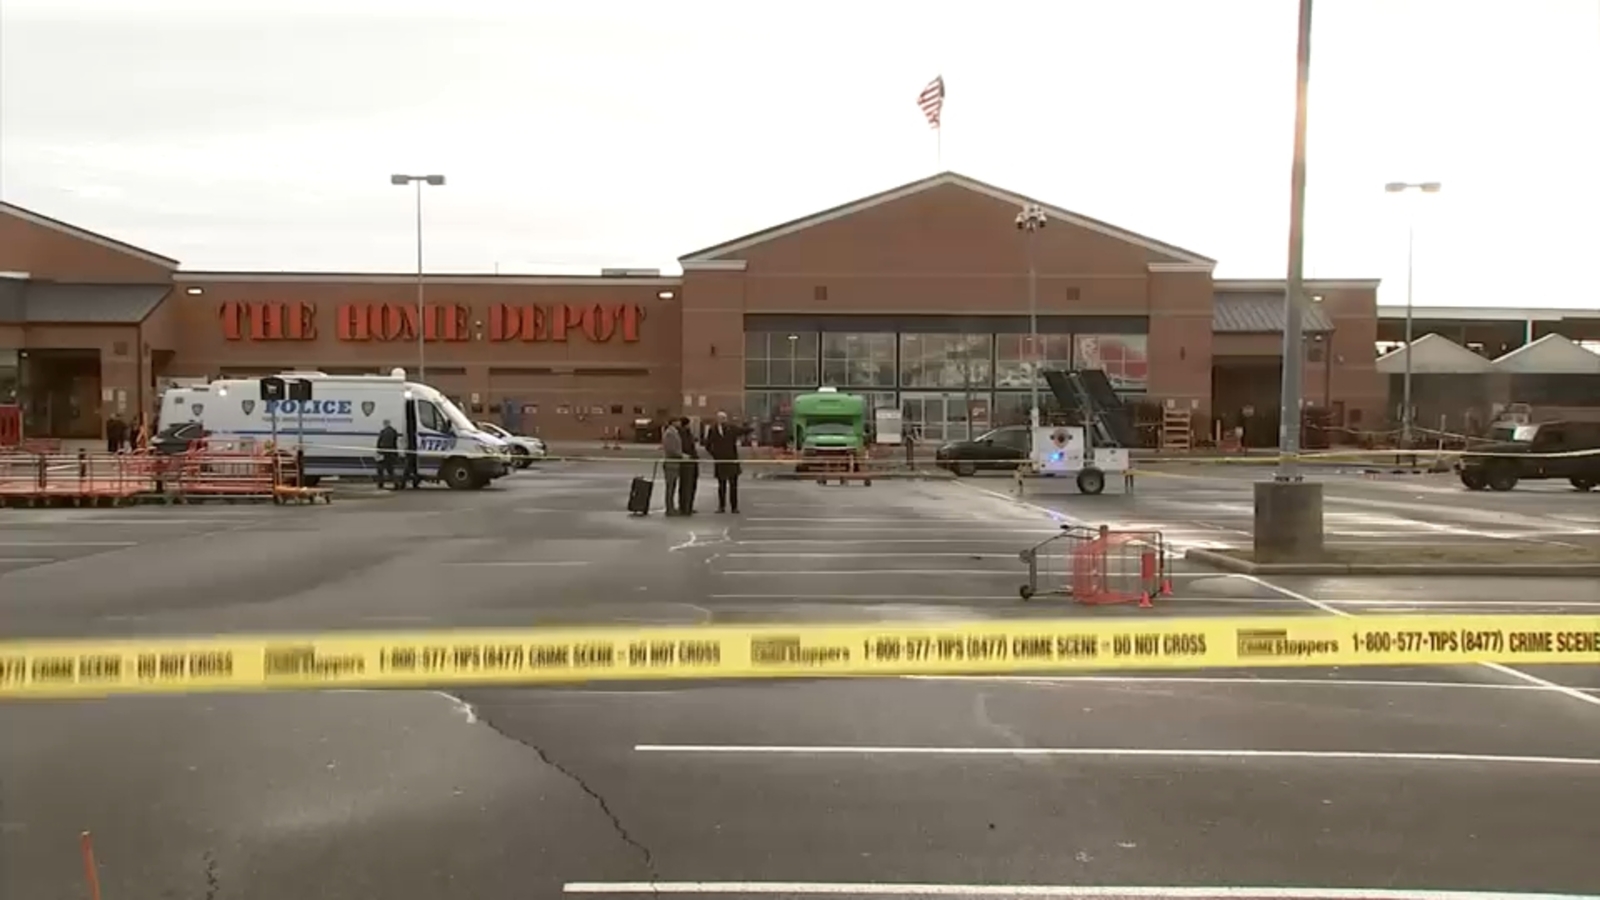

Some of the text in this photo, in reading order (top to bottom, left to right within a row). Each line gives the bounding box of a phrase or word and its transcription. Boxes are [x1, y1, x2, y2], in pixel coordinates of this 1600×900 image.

[219, 301, 648, 342] THE HOME DEPOT
[264, 400, 352, 414] POLICE
[419, 439, 447, 451] NYPD
[967, 635, 1007, 661] (8477)
[1012, 635, 1053, 659] CRIME
[1056, 634, 1098, 659] SCENE
[1113, 633, 1131, 657] DO
[1134, 633, 1161, 656] NOT
[1163, 632, 1207, 656] CROSS
[1461, 629, 1504, 653] (8477)
[1509, 631, 1553, 653] CRIME
[1556, 631, 1600, 653] SCENE
[159, 652, 184, 677] NOT
[529, 644, 567, 669] CRIME
[573, 641, 614, 667] SCENE
[629, 639, 648, 666] DO
[651, 639, 675, 665] NOT
[678, 639, 720, 664] CROSS
